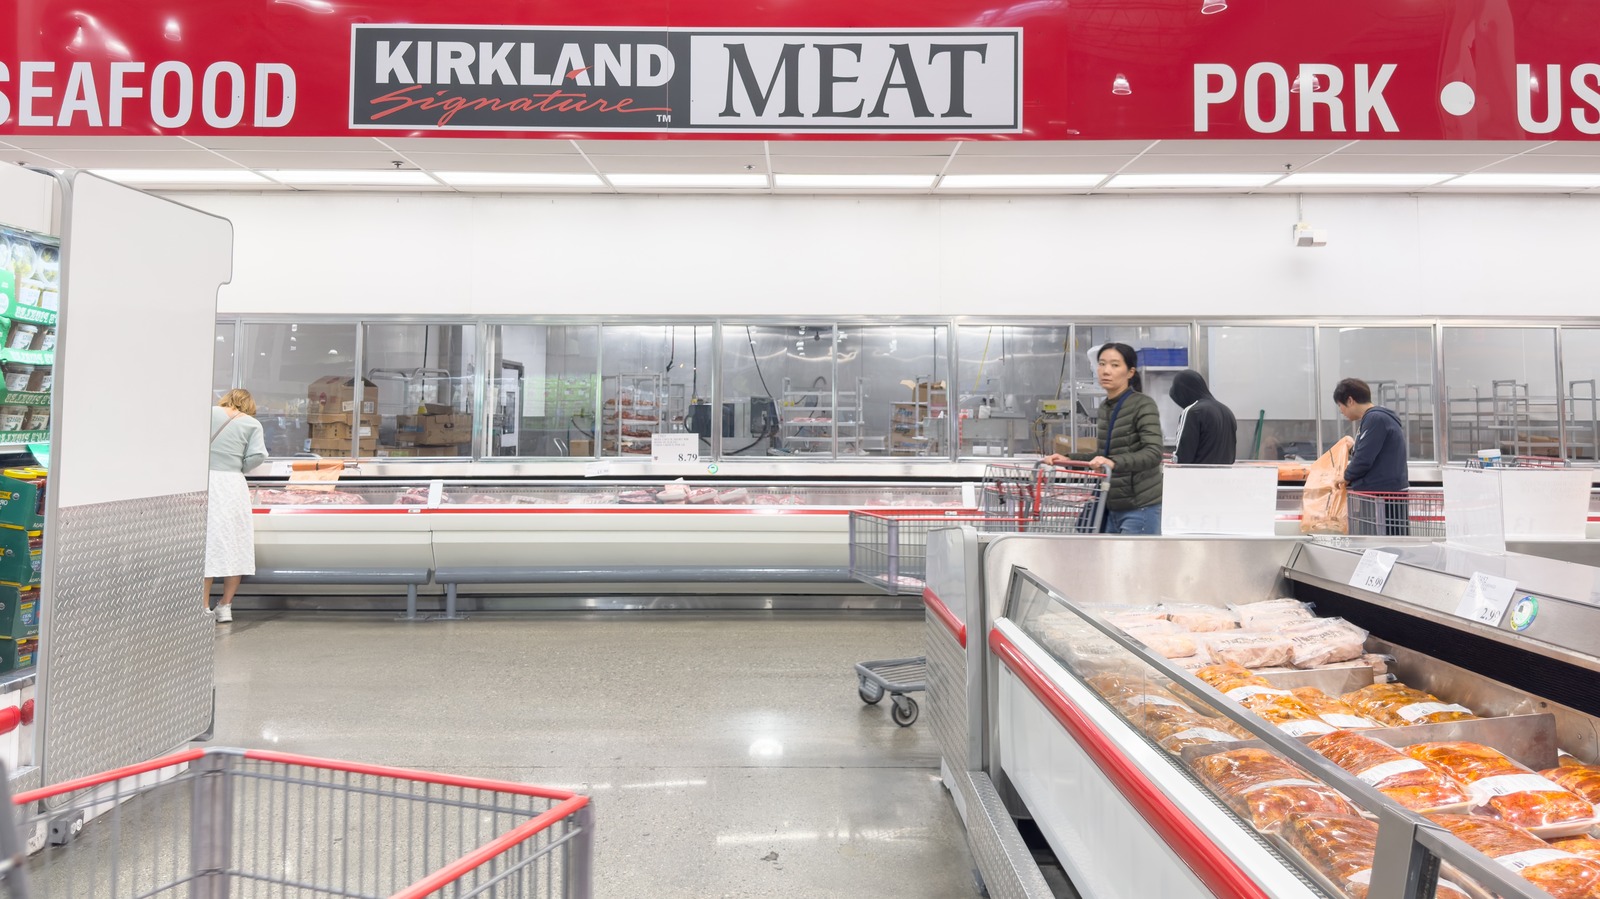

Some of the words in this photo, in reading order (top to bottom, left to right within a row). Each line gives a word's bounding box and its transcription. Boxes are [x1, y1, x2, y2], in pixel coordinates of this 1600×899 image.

[375, 40, 676, 87] KIRKLAND
[718, 43, 988, 118] MEAT
[0, 60, 297, 129] EAFOOD
[370, 84, 672, 127] Signature
[1193, 61, 1401, 134] PORK
[656, 114, 671, 123] TM
[678, 453, 698, 462] 8.79
